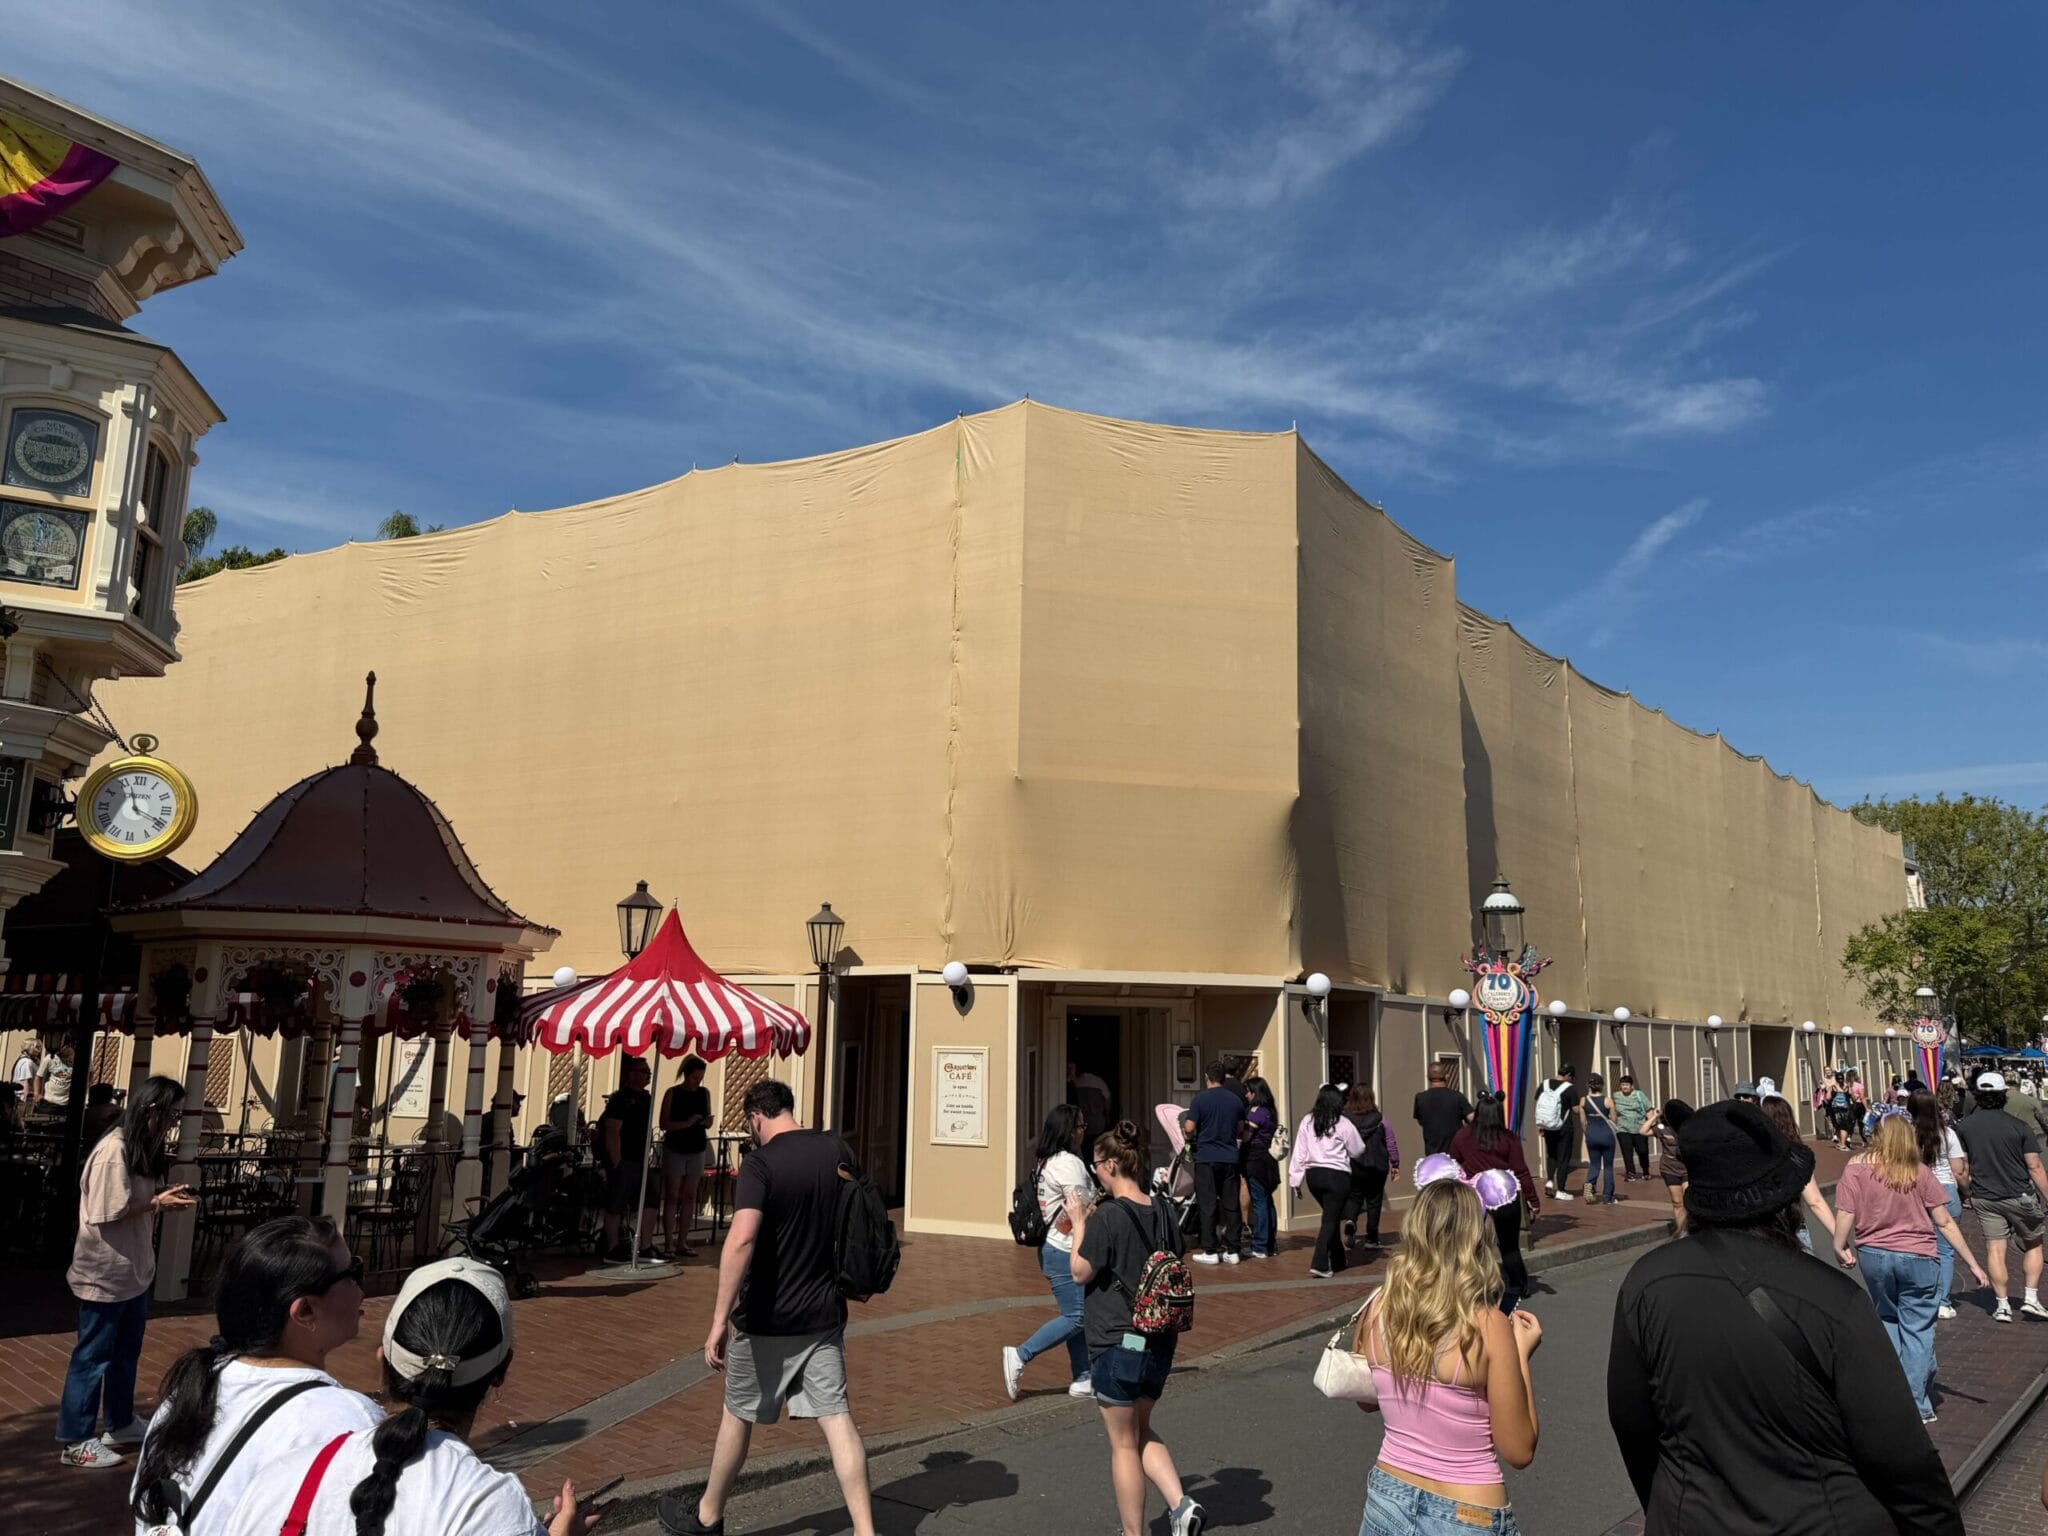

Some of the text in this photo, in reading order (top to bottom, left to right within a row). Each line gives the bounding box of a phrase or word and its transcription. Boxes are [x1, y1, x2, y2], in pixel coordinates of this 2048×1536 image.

[118, 778, 130, 789] XI
[133, 776, 147, 786] XII
[1487, 973, 1511, 990] 70
[1920, 1025, 1934, 1033] 70
[949, 1072, 972, 1080] CAFÉ
